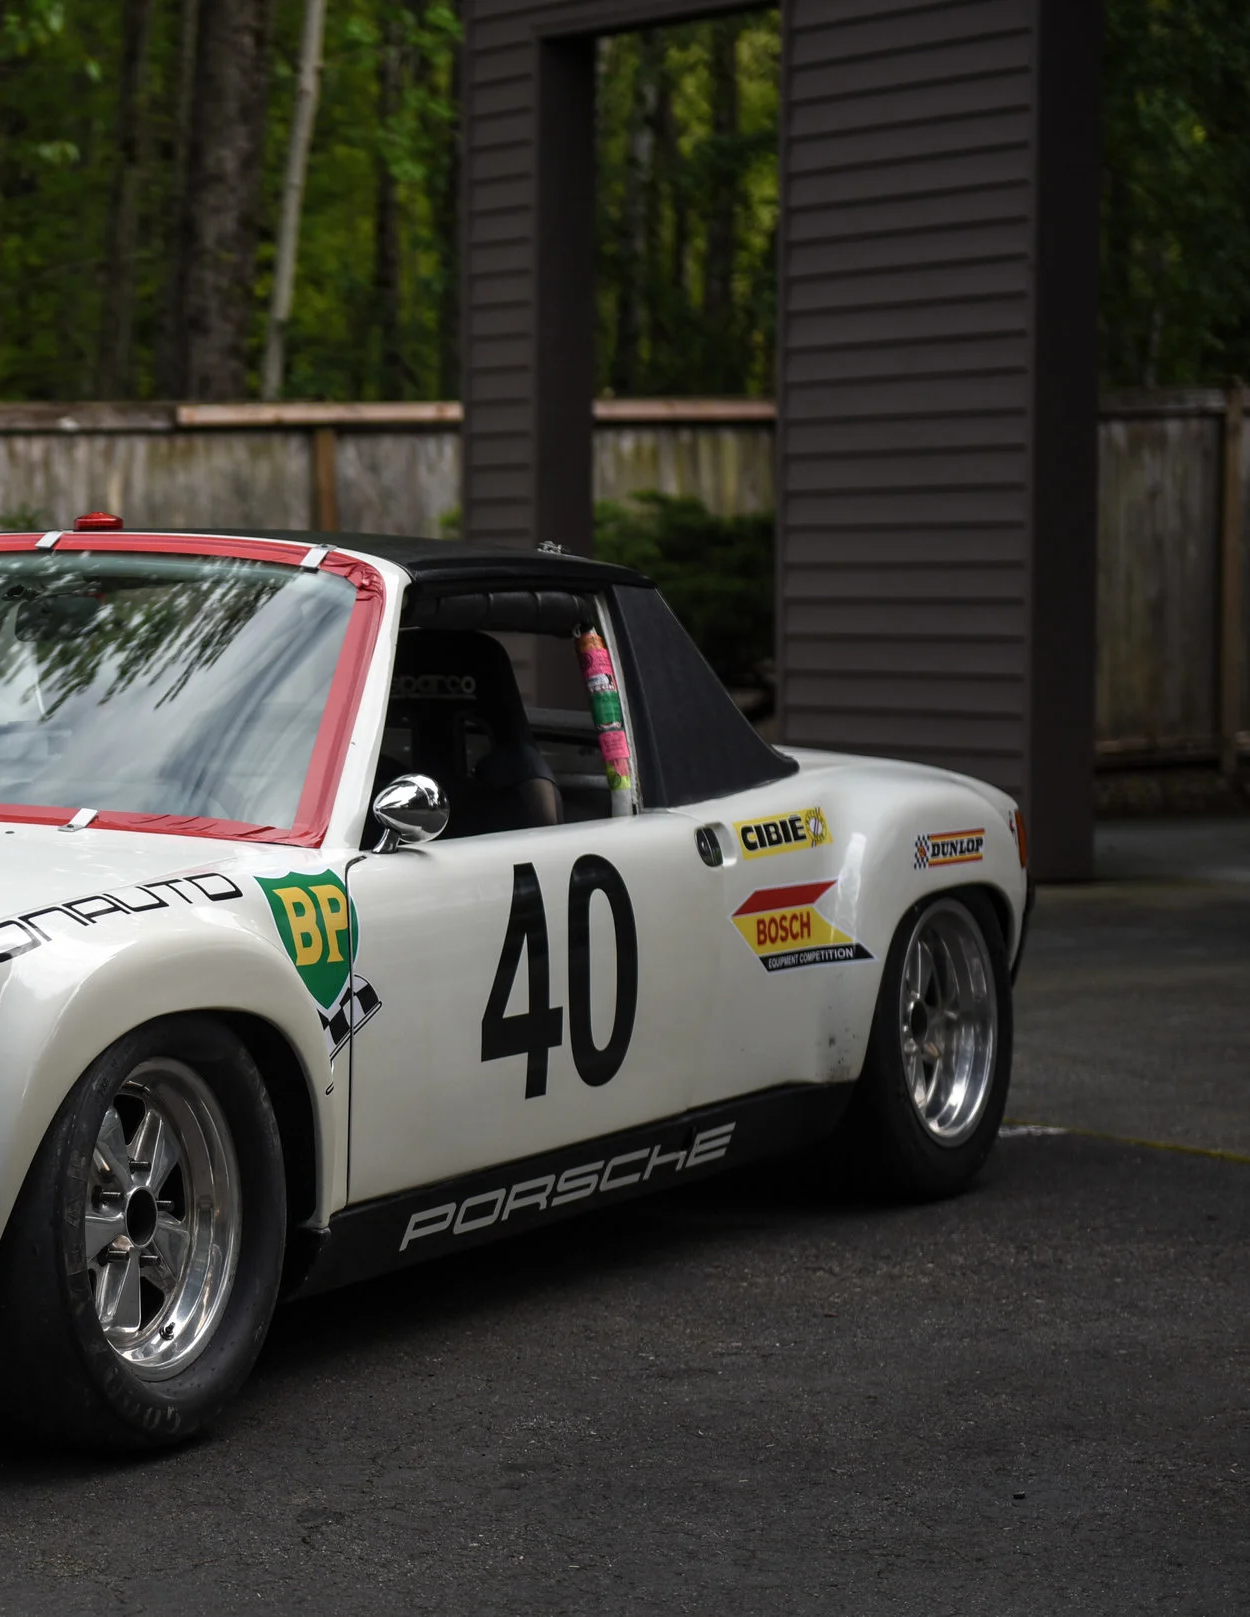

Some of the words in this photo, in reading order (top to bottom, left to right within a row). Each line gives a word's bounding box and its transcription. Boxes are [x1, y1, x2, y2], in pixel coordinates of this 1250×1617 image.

[931, 836, 984, 857] DUNLOP
[275, 884, 349, 967] BP
[756, 911, 811, 946] BOSCH
[481, 854, 639, 1100] 40
[768, 954, 799, 970] EQUIPMENT
[799, 947, 854, 964] COMPETITION
[399, 1121, 737, 1252] PORSCHE
